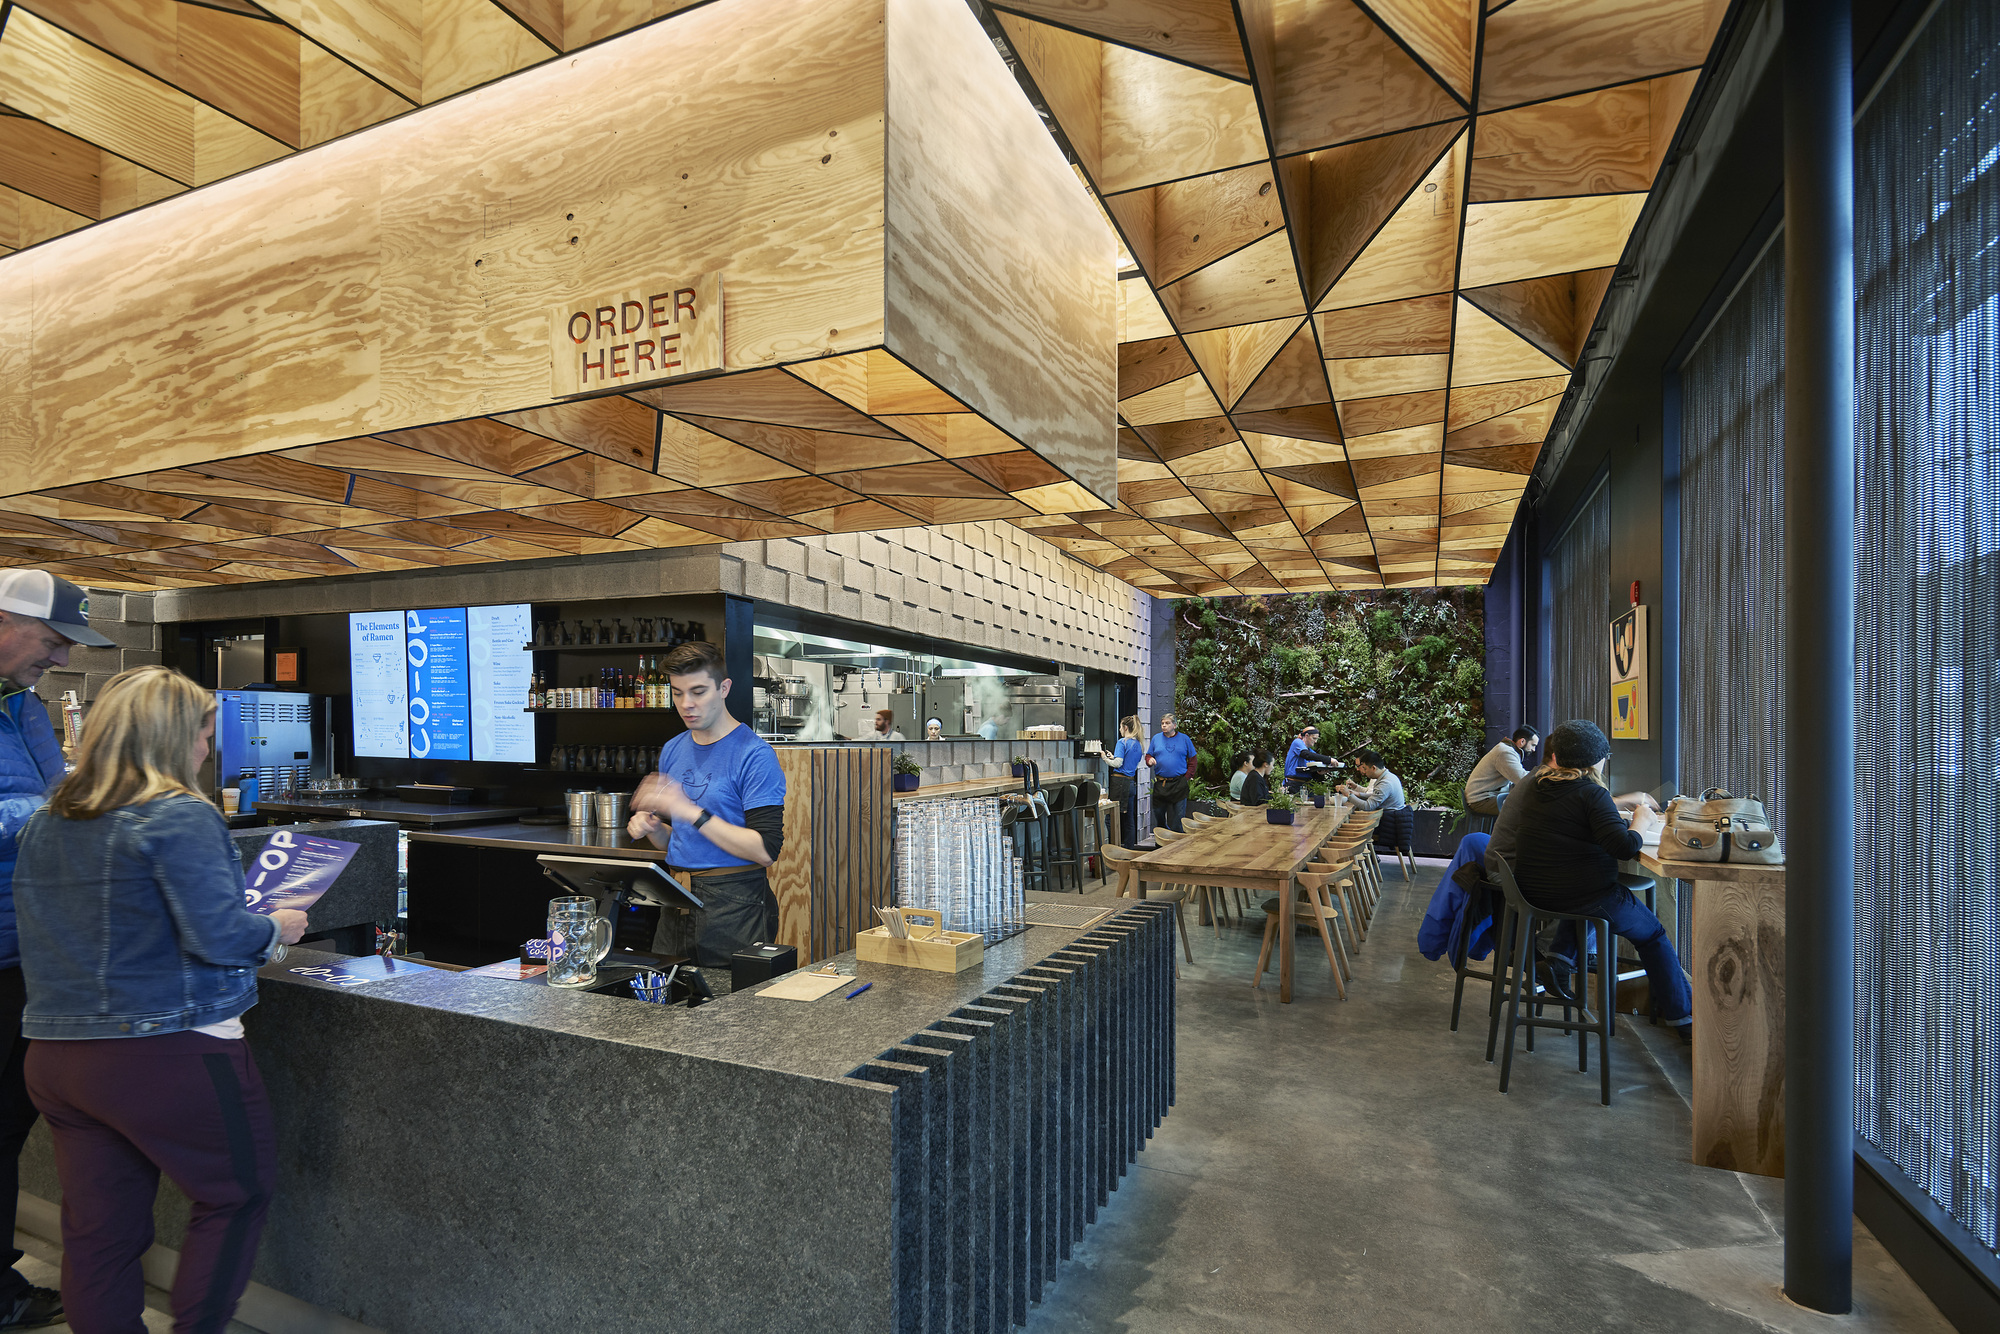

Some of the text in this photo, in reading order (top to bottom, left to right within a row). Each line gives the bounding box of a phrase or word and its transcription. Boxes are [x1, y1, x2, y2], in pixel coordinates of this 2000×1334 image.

[567, 287, 697, 345] ORDER
[582, 332, 682, 384] HERE
[355, 621, 400, 632] The Elements
[361, 632, 394, 642] of Ramen
[407, 610, 431, 759] CO-OP
[289, 966, 370, 986] CO-OP
